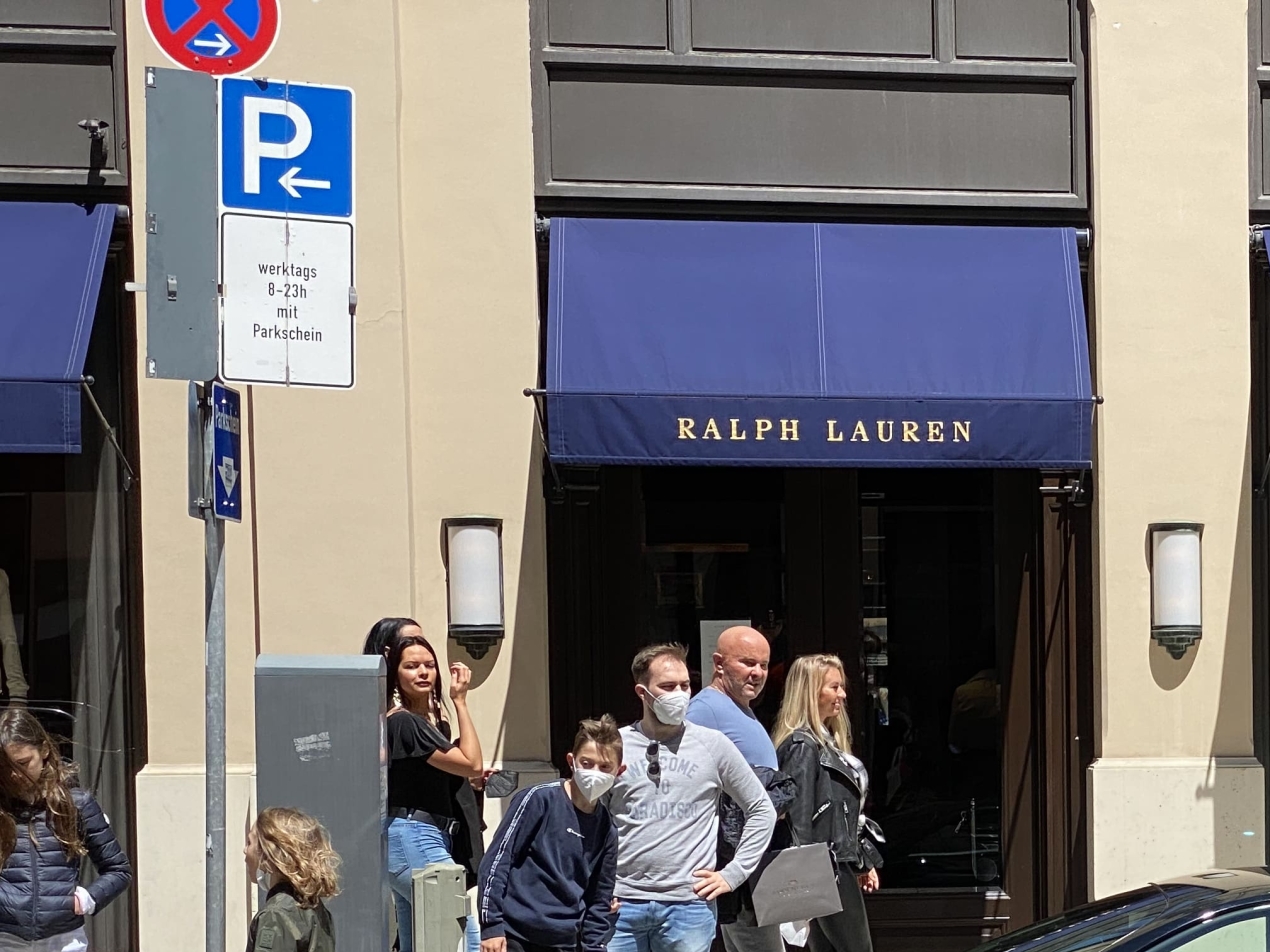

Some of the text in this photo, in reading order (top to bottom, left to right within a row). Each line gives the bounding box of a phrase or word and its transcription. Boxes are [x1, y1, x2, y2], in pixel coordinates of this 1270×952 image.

[244, 95, 312, 194] P
[258, 262, 317, 281] werktags
[268, 283, 307, 299] 8-23h
[276, 305, 298, 320] mit
[253, 323, 322, 342] Parkschein
[677, 417, 971, 443] RALPH LAUREN
[627, 756, 699, 779] WECOME
